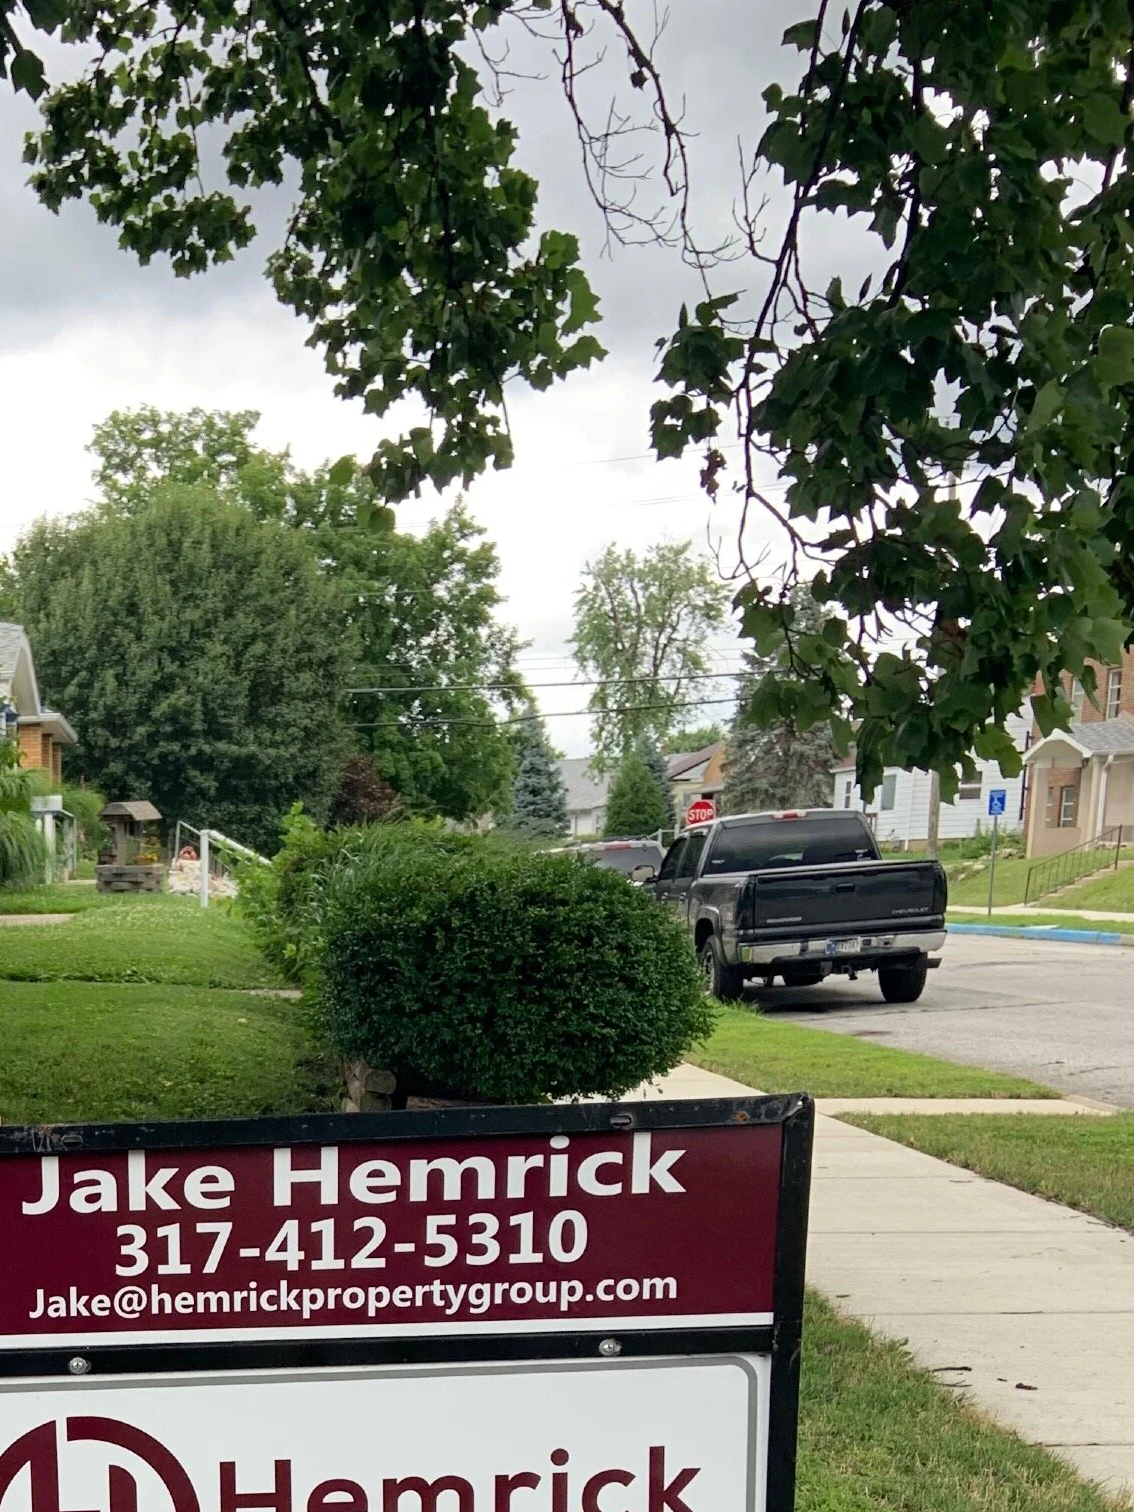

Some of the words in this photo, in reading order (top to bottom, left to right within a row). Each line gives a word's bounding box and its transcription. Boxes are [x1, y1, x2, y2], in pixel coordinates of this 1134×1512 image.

[688, 808, 714, 821] STOP
[21, 1148, 236, 1216] Jake
[272, 1132, 688, 1208] Hemrick
[114, 1209, 590, 1278] 317-412-5310
[28, 1275, 679, 1320] Jake@hemrickpropertygroup.com
